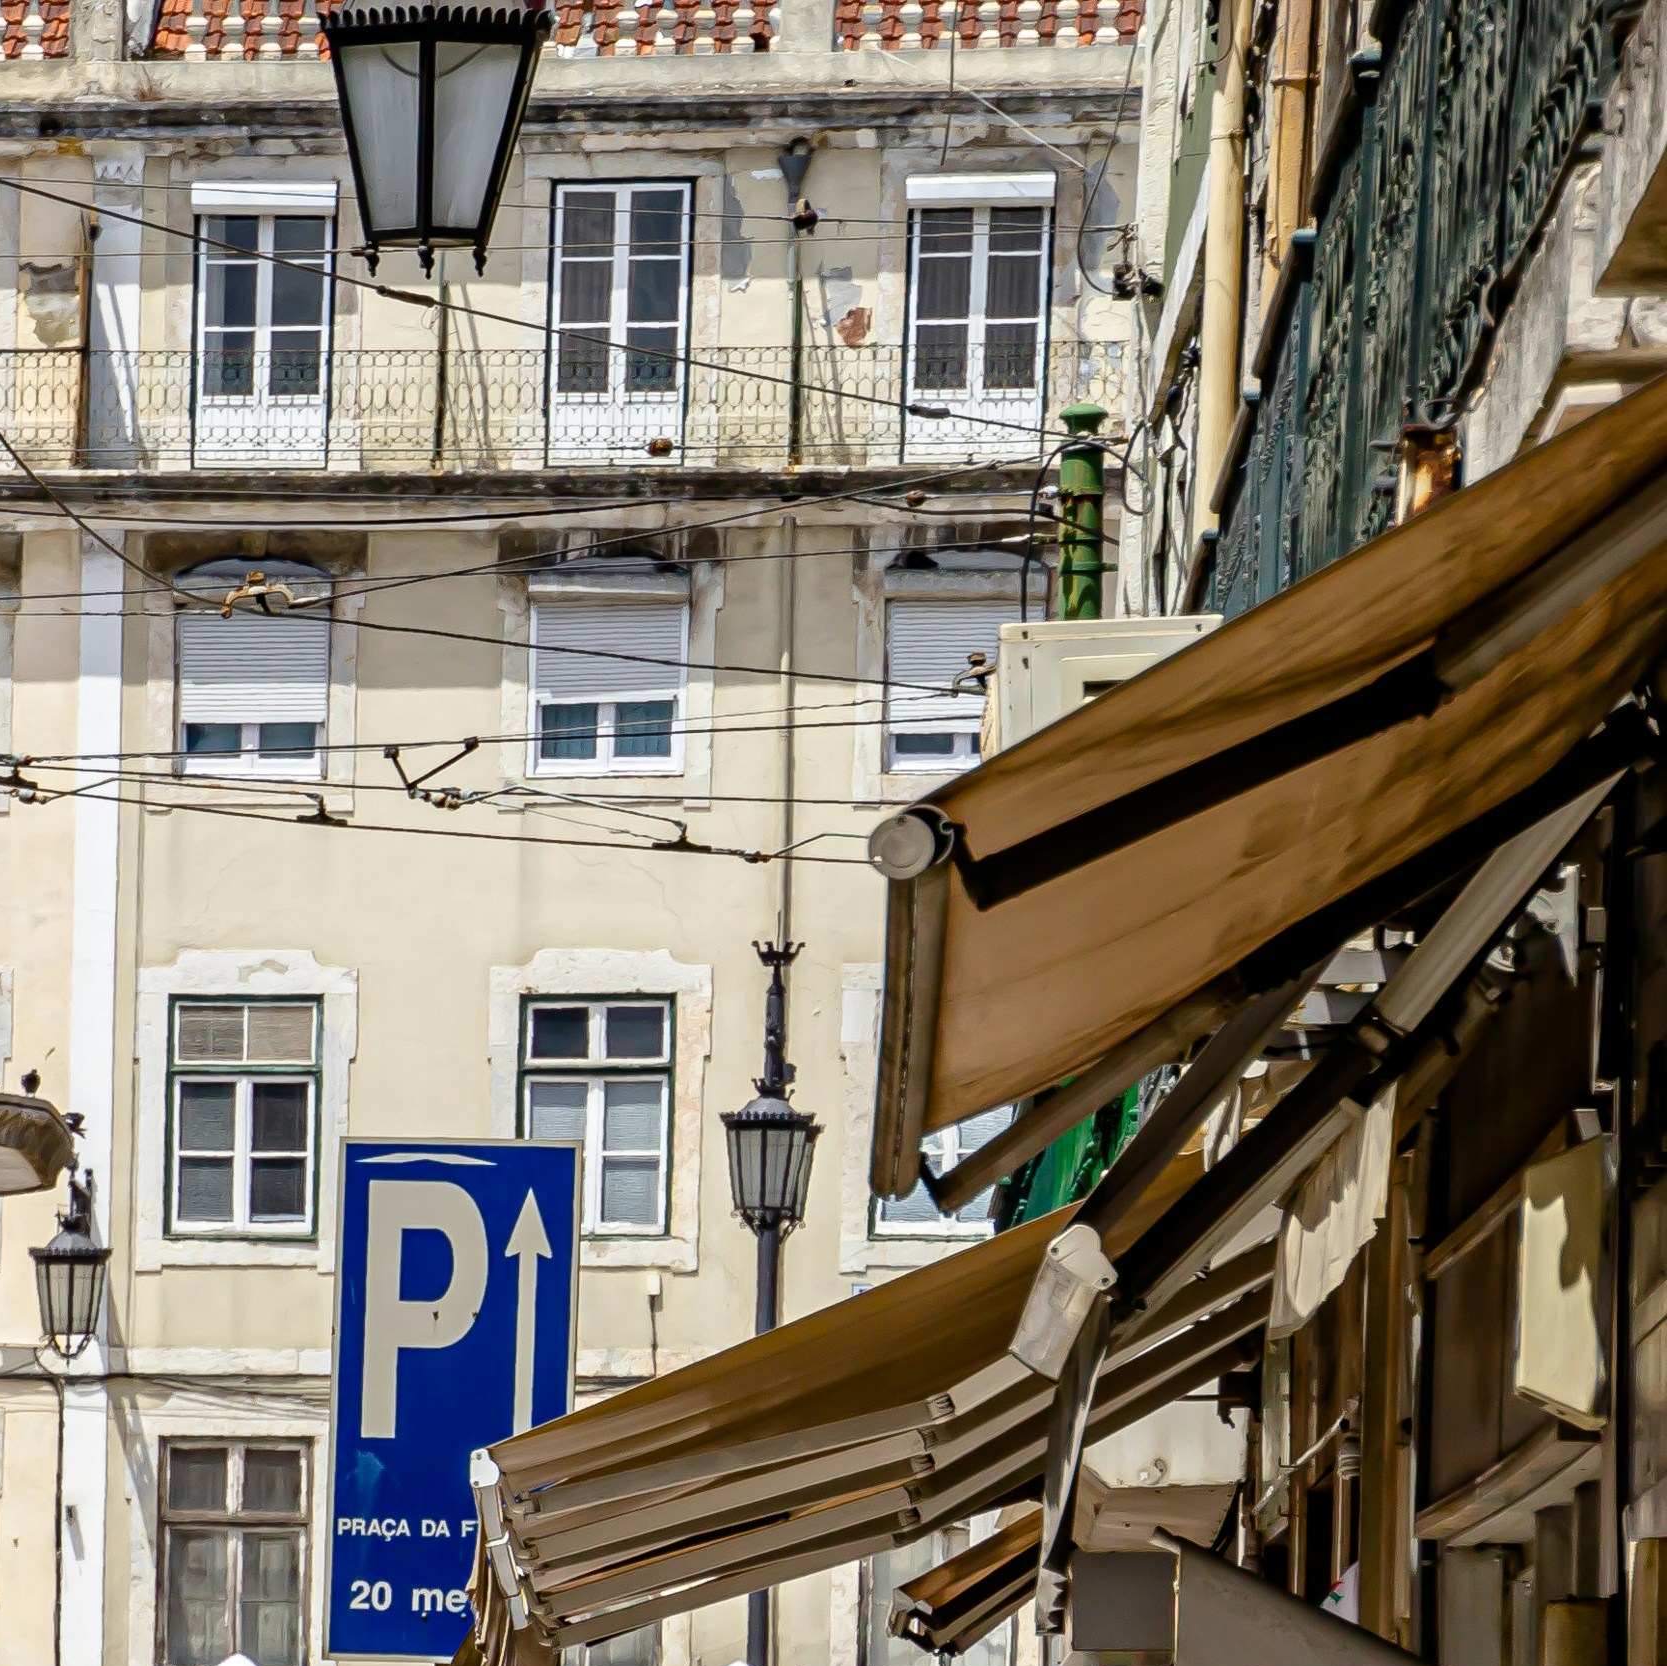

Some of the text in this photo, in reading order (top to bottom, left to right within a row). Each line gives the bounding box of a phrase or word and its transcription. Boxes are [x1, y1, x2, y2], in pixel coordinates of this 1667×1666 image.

[361, 1179, 489, 1439] P
[337, 1518, 478, 1542] PRAÇA DA F
[349, 1580, 469, 1613] 20 me
